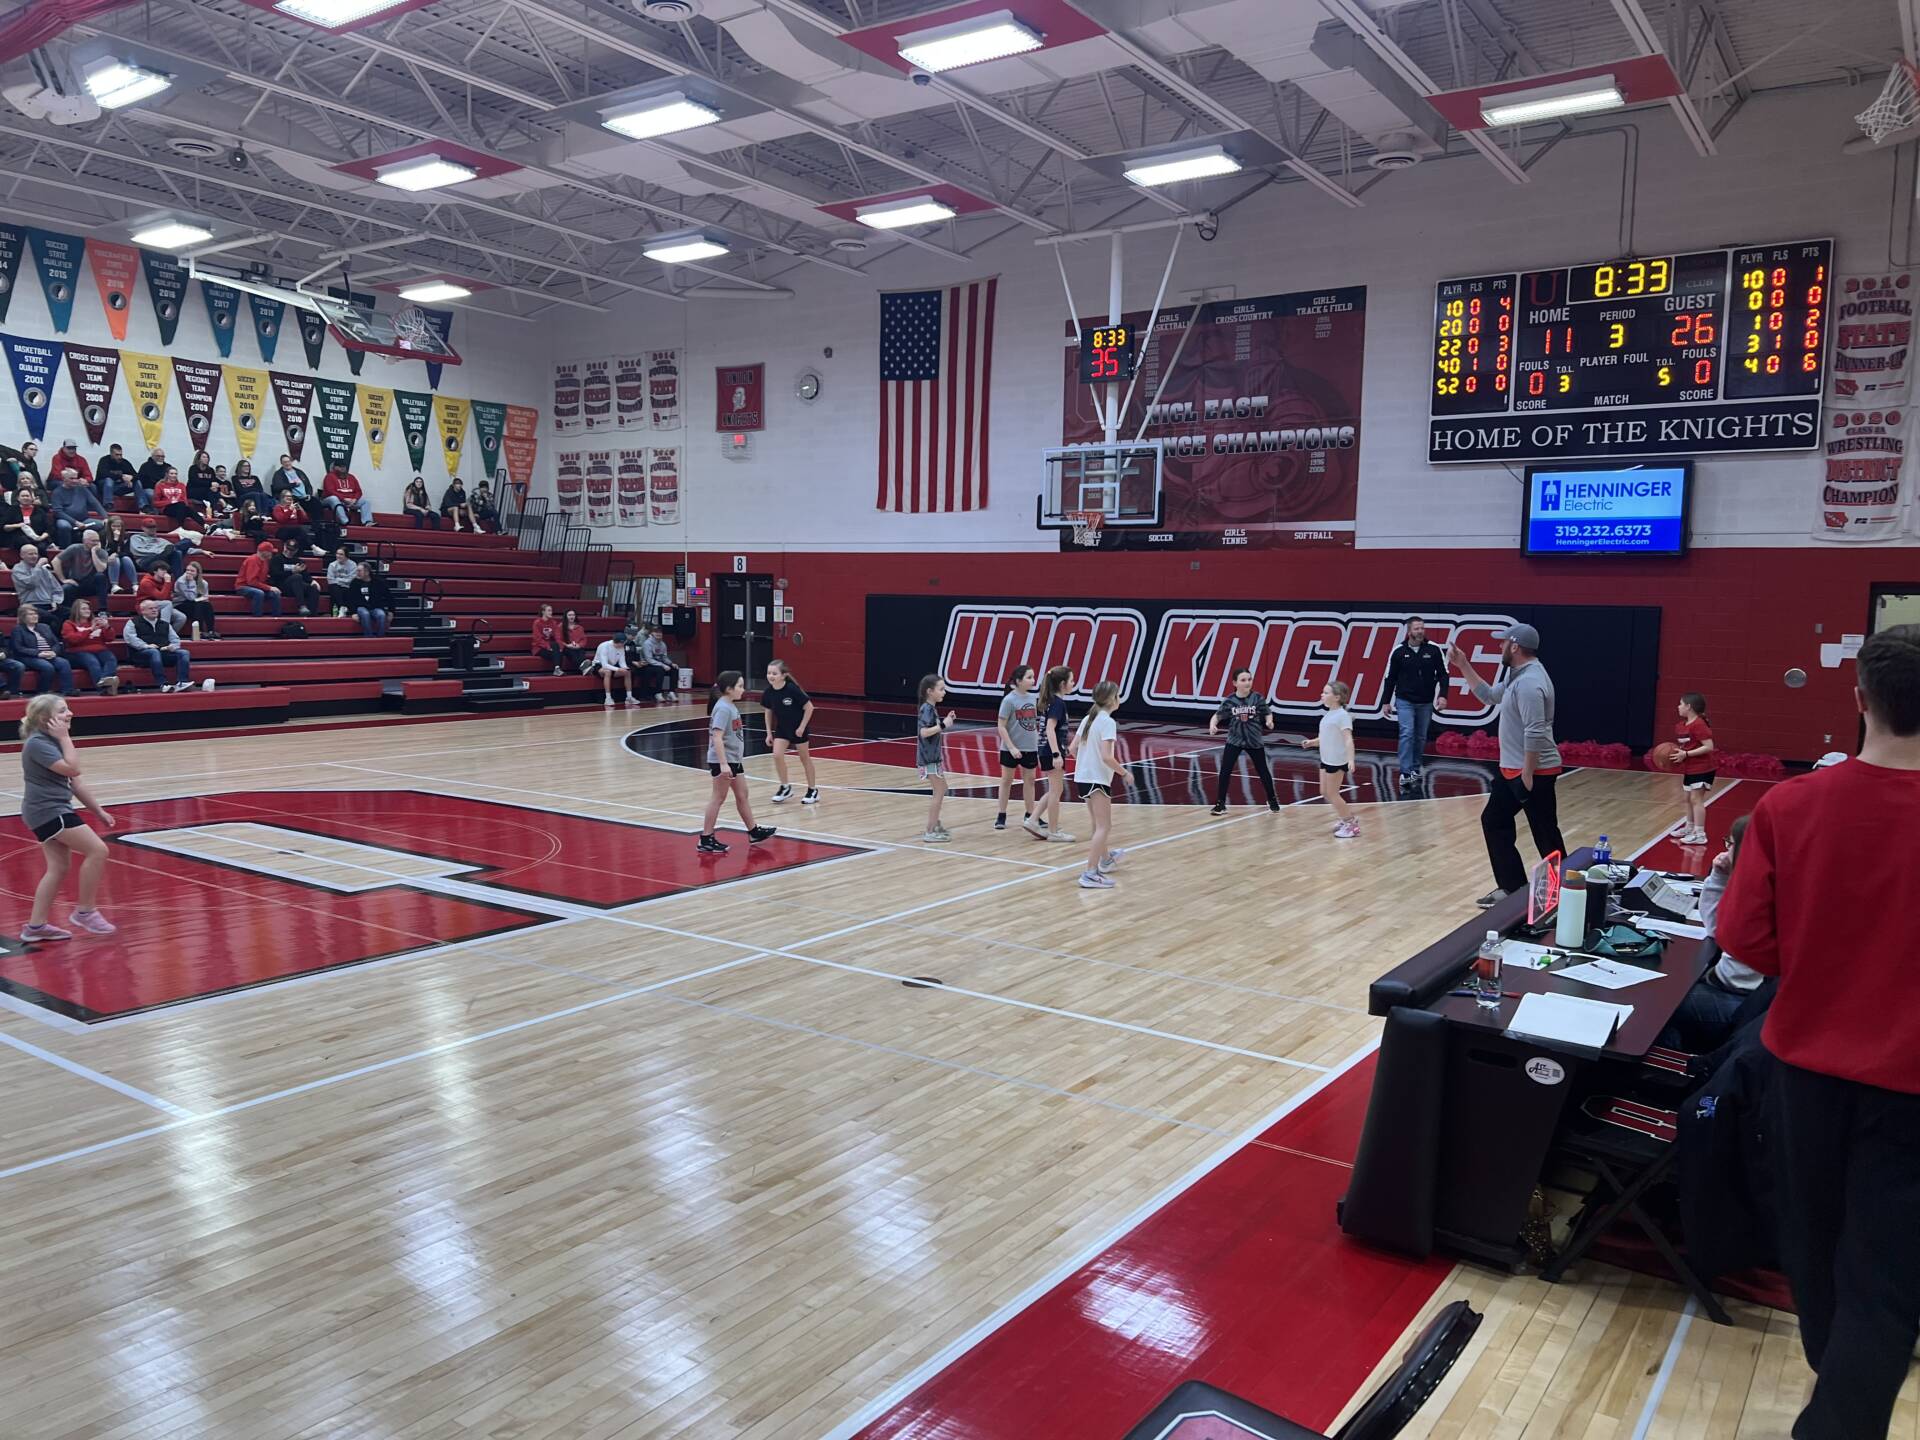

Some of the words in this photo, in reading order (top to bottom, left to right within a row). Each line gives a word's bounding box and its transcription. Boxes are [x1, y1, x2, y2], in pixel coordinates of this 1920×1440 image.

[1740, 252, 1764, 264] PLYR
[1772, 249, 1789, 260] FLS
[1802, 246, 1820, 258] PTS
[1594, 259, 1669, 298] 8:33
[1743, 269, 1765, 290] 10
[1771, 267, 1787, 287] 0
[1816, 264, 1824, 282] 1
[1443, 284, 1463, 295] PLYR
[1470, 282, 1483, 292] FLS
[1493, 280, 1507, 290] PTS
[1312, 295, 1337, 305] GIRLS
[1664, 293, 1716, 312] GUEST
[1749, 290, 1763, 311] 0
[1770, 288, 1785, 308] 0
[1807, 285, 1822, 305] 0
[1233, 305, 1256, 314] GIRLS
[1296, 306, 1324, 316] TRACK
[1330, 302, 1353, 312] FIELD
[1446, 299, 1464, 318] 10
[1469, 298, 1481, 316] 0
[1500, 296, 1511, 311] 4
[1839, 299, 1913, 321] FOOTBALL
[1159, 313, 1180, 323] GIRLS
[1215, 315, 1238, 325] CROSS
[1238, 311, 1273, 322] COUNTRY
[1529, 307, 1571, 325] HOME
[1599, 309, 1637, 322] PERIOD
[1753, 313, 1762, 331] 1
[1768, 311, 1784, 331] 0
[1806, 307, 1821, 328] 2
[1439, 318, 1463, 337] 20
[1469, 316, 1480, 335] 0
[1498, 313, 1510, 332] 0
[1670, 312, 1715, 347] 26
[1093, 328, 1126, 348] 8:33
[1544, 326, 1574, 355] 11
[1609, 322, 1625, 349] 3
[1747, 333, 1761, 354] 3
[1775, 333, 1782, 350] 1
[1803, 328, 1820, 349] 0
[14, 344, 53, 357] BASKETBALL
[1438, 338, 1462, 357] 22
[1467, 336, 1479, 355] 0
[1499, 334, 1509, 352] 3
[69, 351, 90, 362] CROSS
[90, 355, 118, 365] COUNTRY
[1682, 346, 1718, 359] FOULS
[24, 355, 43, 365] STATE
[138, 361, 159, 371] SOCCER
[1091, 347, 1118, 378] 35
[1438, 356, 1461, 375] 40
[1472, 357, 1479, 372] 1
[1496, 353, 1508, 371] 0
[1519, 360, 1550, 372] FOULS
[1579, 355, 1618, 367] PLAYER
[1623, 352, 1650, 364] FOUL
[1744, 357, 1759, 374] 4
[1765, 354, 1781, 374] 0
[1802, 352, 1817, 372] 6
[18, 363, 49, 375] QUALIFIER
[79, 363, 108, 374] REGIONAL
[175, 364, 195, 374] CROSS
[195, 367, 220, 377] COUNTRY
[1694, 358, 1712, 385] 0
[24, 374, 44, 385] 2001
[86, 373, 103, 382] TEAM
[140, 372, 157, 380] STATE
[185, 374, 211, 385] REGIONAL
[80, 382, 110, 393] CHAMPION
[135, 380, 162, 390] QUALIFIER
[191, 384, 206, 393] TEAM
[290, 381, 313, 390] COUNTRY
[1436, 377, 1460, 396] 52
[1465, 375, 1477, 393] 0
[1495, 373, 1507, 391] 0
[1528, 370, 1545, 396] 0
[1559, 374, 1571, 393] 3
[185, 392, 213, 403] CHAMPION
[322, 386, 351, 397] VOLLEYBALL
[1679, 388, 1715, 401] SCORE
[329, 396, 344, 404] STATE
[1516, 399, 1547, 411] SCORE
[1594, 394, 1630, 406] MATCH
[325, 403, 349, 412] QUALIFIER
[1203, 395, 1270, 420] EAST
[322, 426, 351, 437] VOLLEYBALL
[1433, 427, 1522, 451] HOME
[1531, 424, 1574, 447] OF
[1582, 419, 1648, 445] THE
[1658, 412, 1814, 442] KNIGHTS
[330, 435, 345, 443] STATE
[1212, 425, 1355, 455] CHAMPIONS
[326, 442, 349, 452] QUALIFIER
[1826, 437, 1905, 457] WRESTLING
[1564, 481, 1672, 499] HENNINGER
[1823, 482, 1900, 506] CHAMPION
[1563, 499, 1613, 512] Electric
[1224, 529, 1246, 537] GIRLS
[1294, 532, 1334, 540] SOFTBALL
[1554, 524, 1652, 537] 319.232.6373
[1148, 534, 1174, 542] SOCCER
[1221, 537, 1248, 545] TENNIS
[1555, 537, 1650, 546] HenningerElectric.com
[736, 557, 744, 572] 8
[942, 608, 1142, 695] UNION
